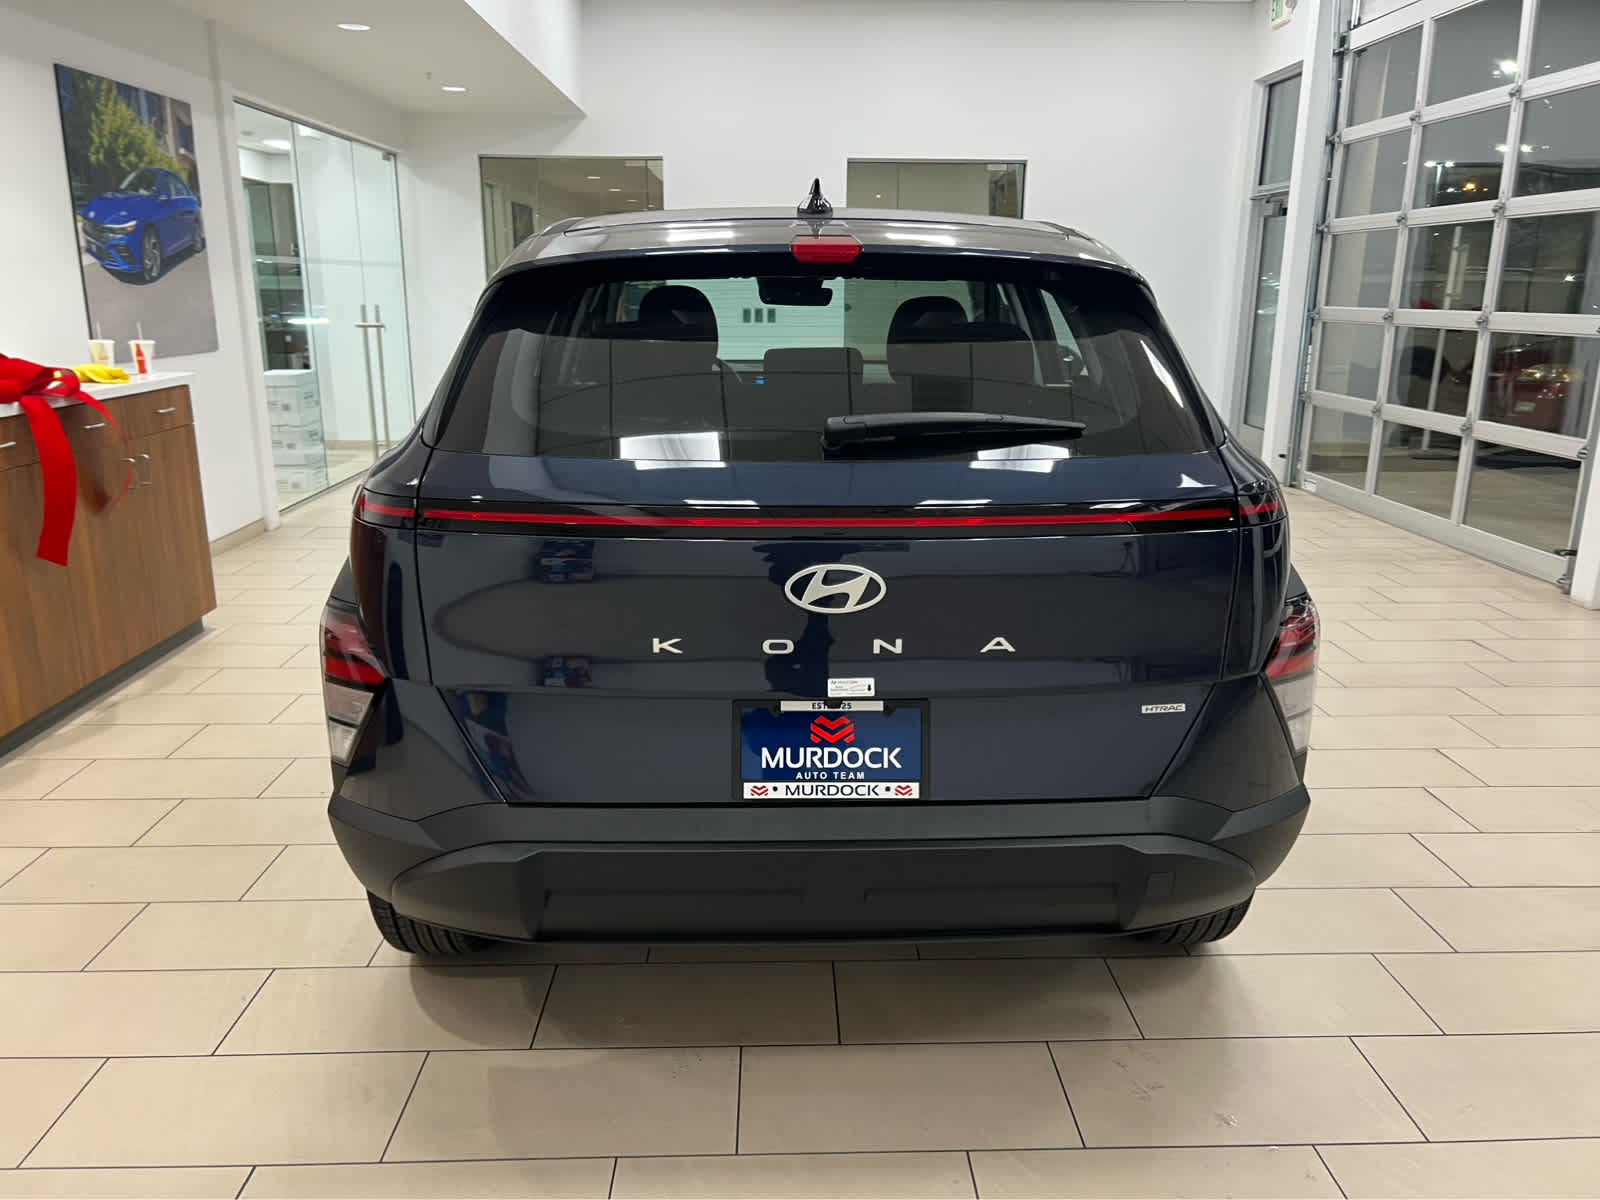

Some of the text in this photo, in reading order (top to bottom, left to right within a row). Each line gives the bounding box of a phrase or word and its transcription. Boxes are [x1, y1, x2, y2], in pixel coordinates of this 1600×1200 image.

[652, 637, 1016, 654] KONA
[761, 747, 902, 769] MURDOCK
[795, 772, 865, 780] AUTO TEAM
[785, 785, 880, 796] MURDOCK
